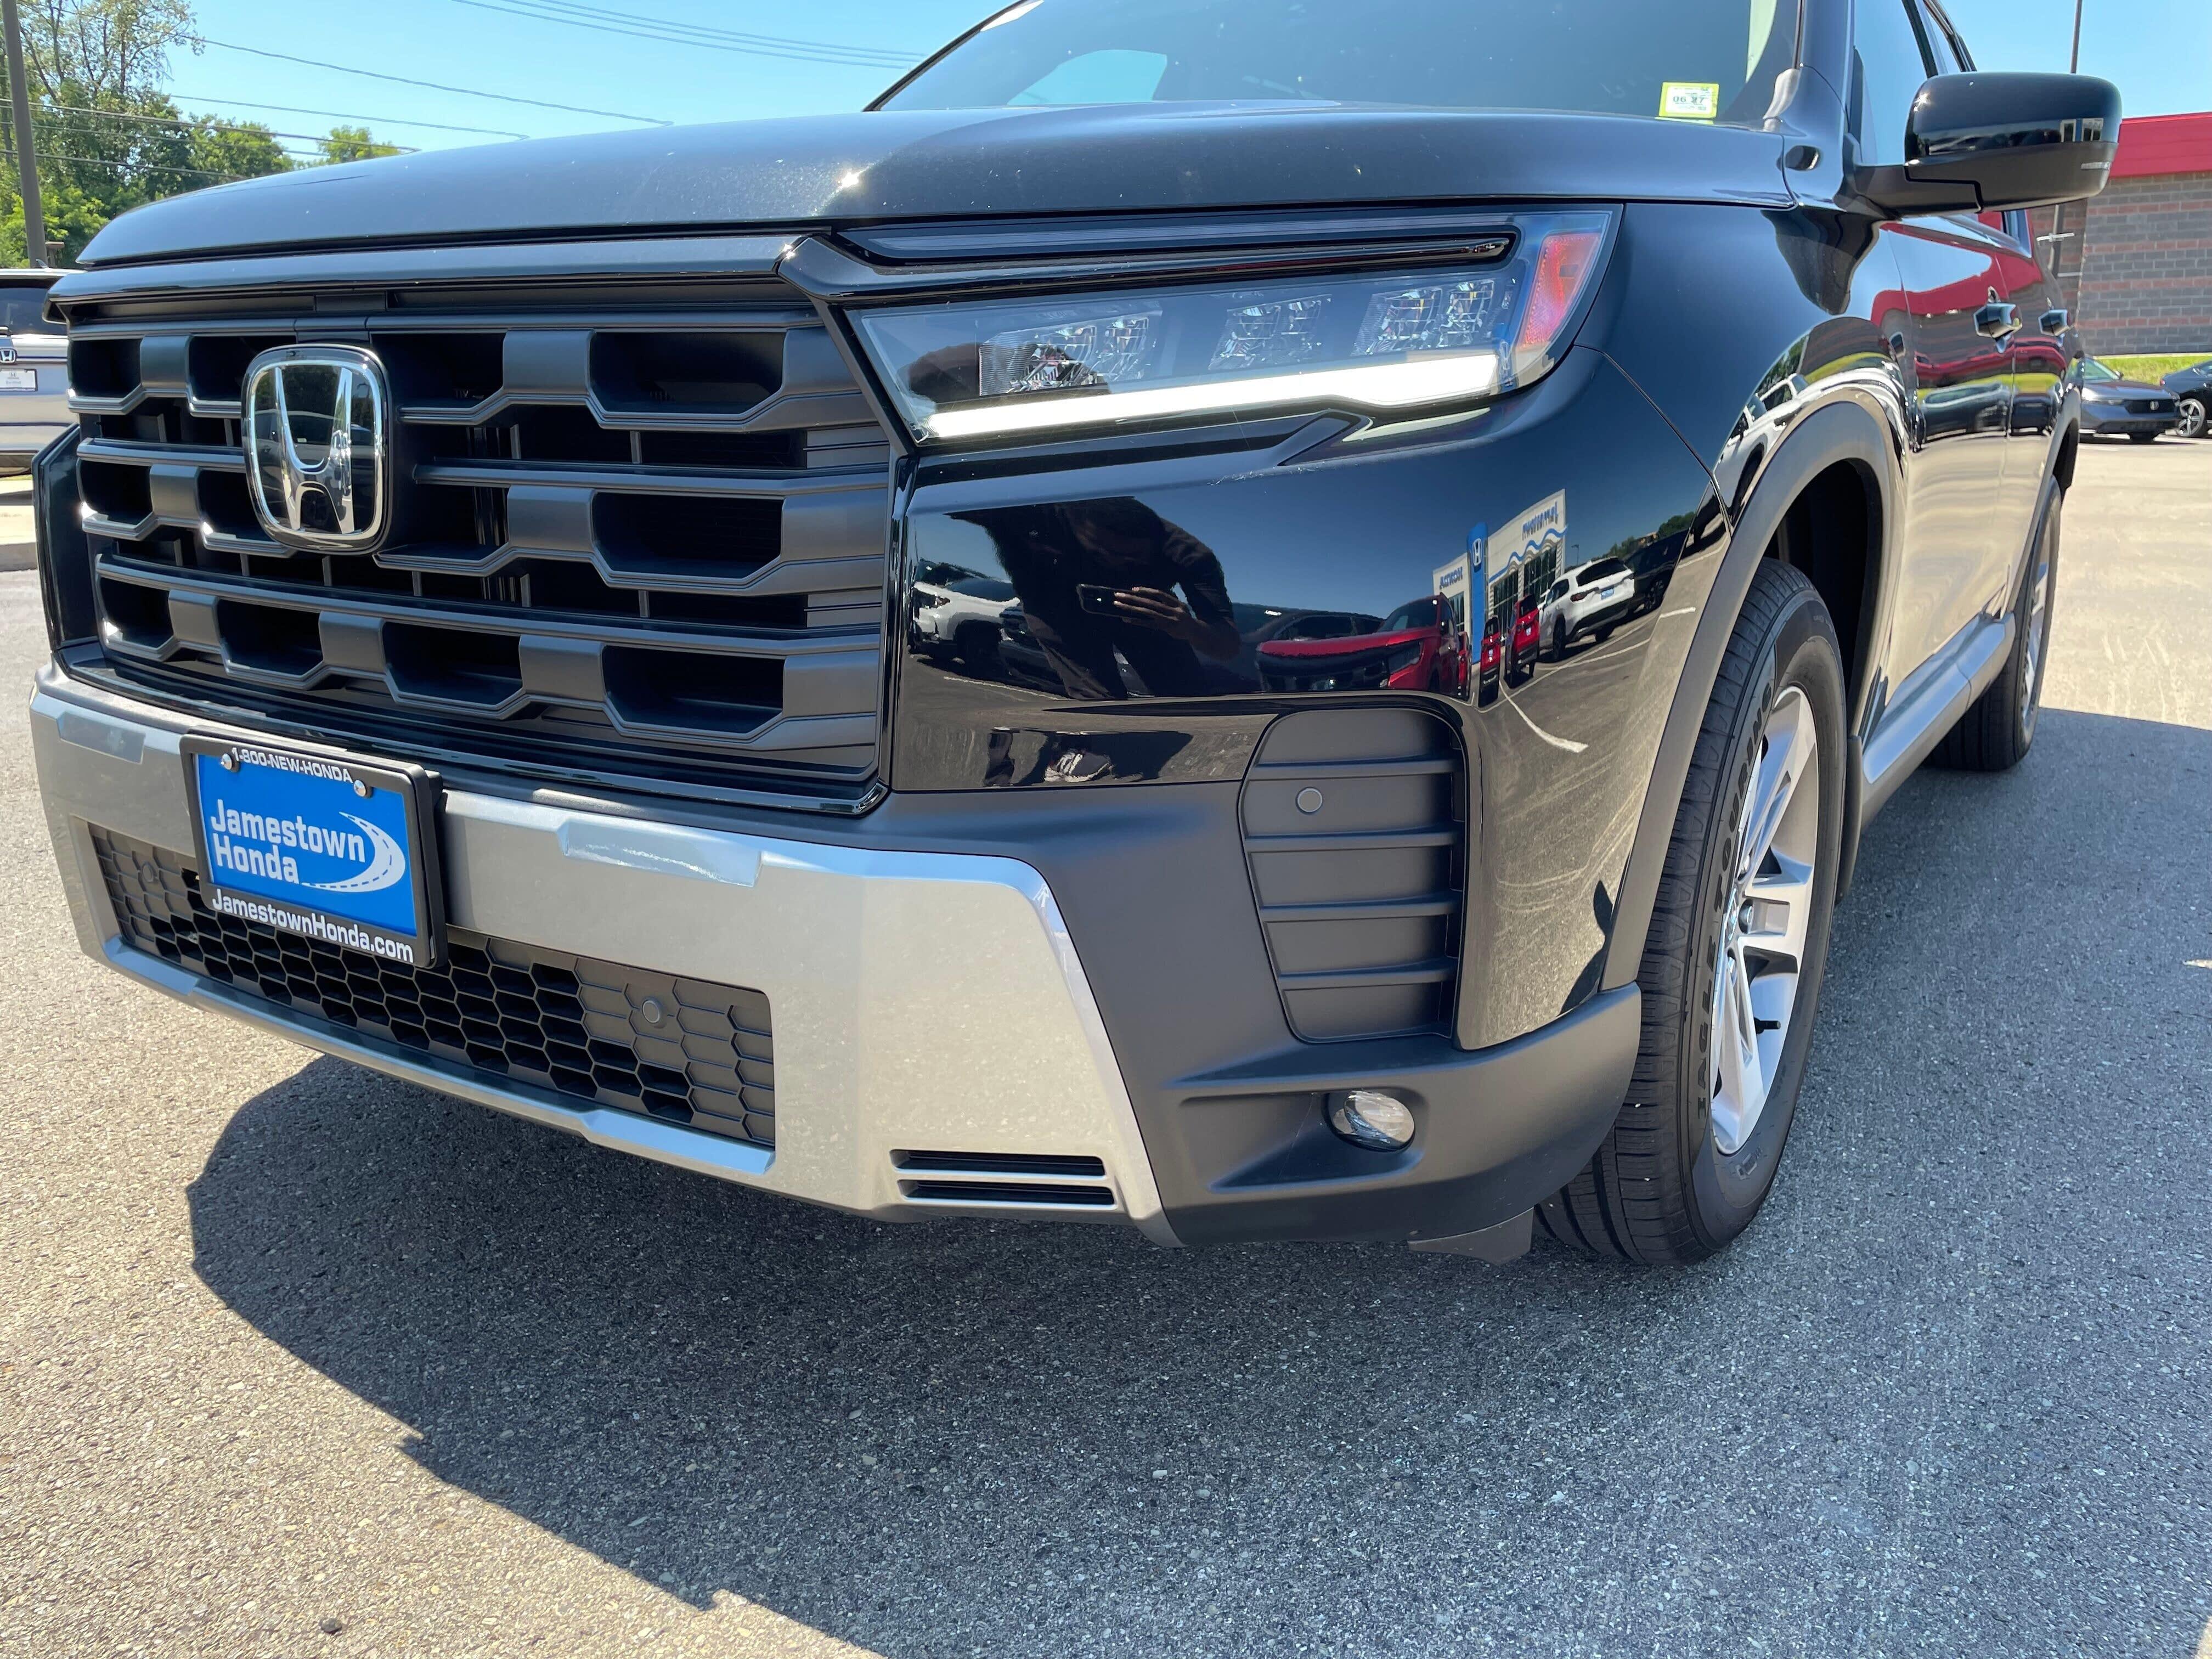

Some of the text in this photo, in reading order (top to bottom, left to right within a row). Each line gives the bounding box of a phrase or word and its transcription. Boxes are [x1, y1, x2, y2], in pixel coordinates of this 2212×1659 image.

[231, 747, 353, 783] 1-800-NEW-HONDA
[1713, 682, 1772, 913] TOURING
[211, 799, 365, 863] Jamestown
[213, 833, 300, 884] Honda
[212, 888, 414, 963] JamestownHonda.com
[1697, 935, 1716, 1120] EAGLE
